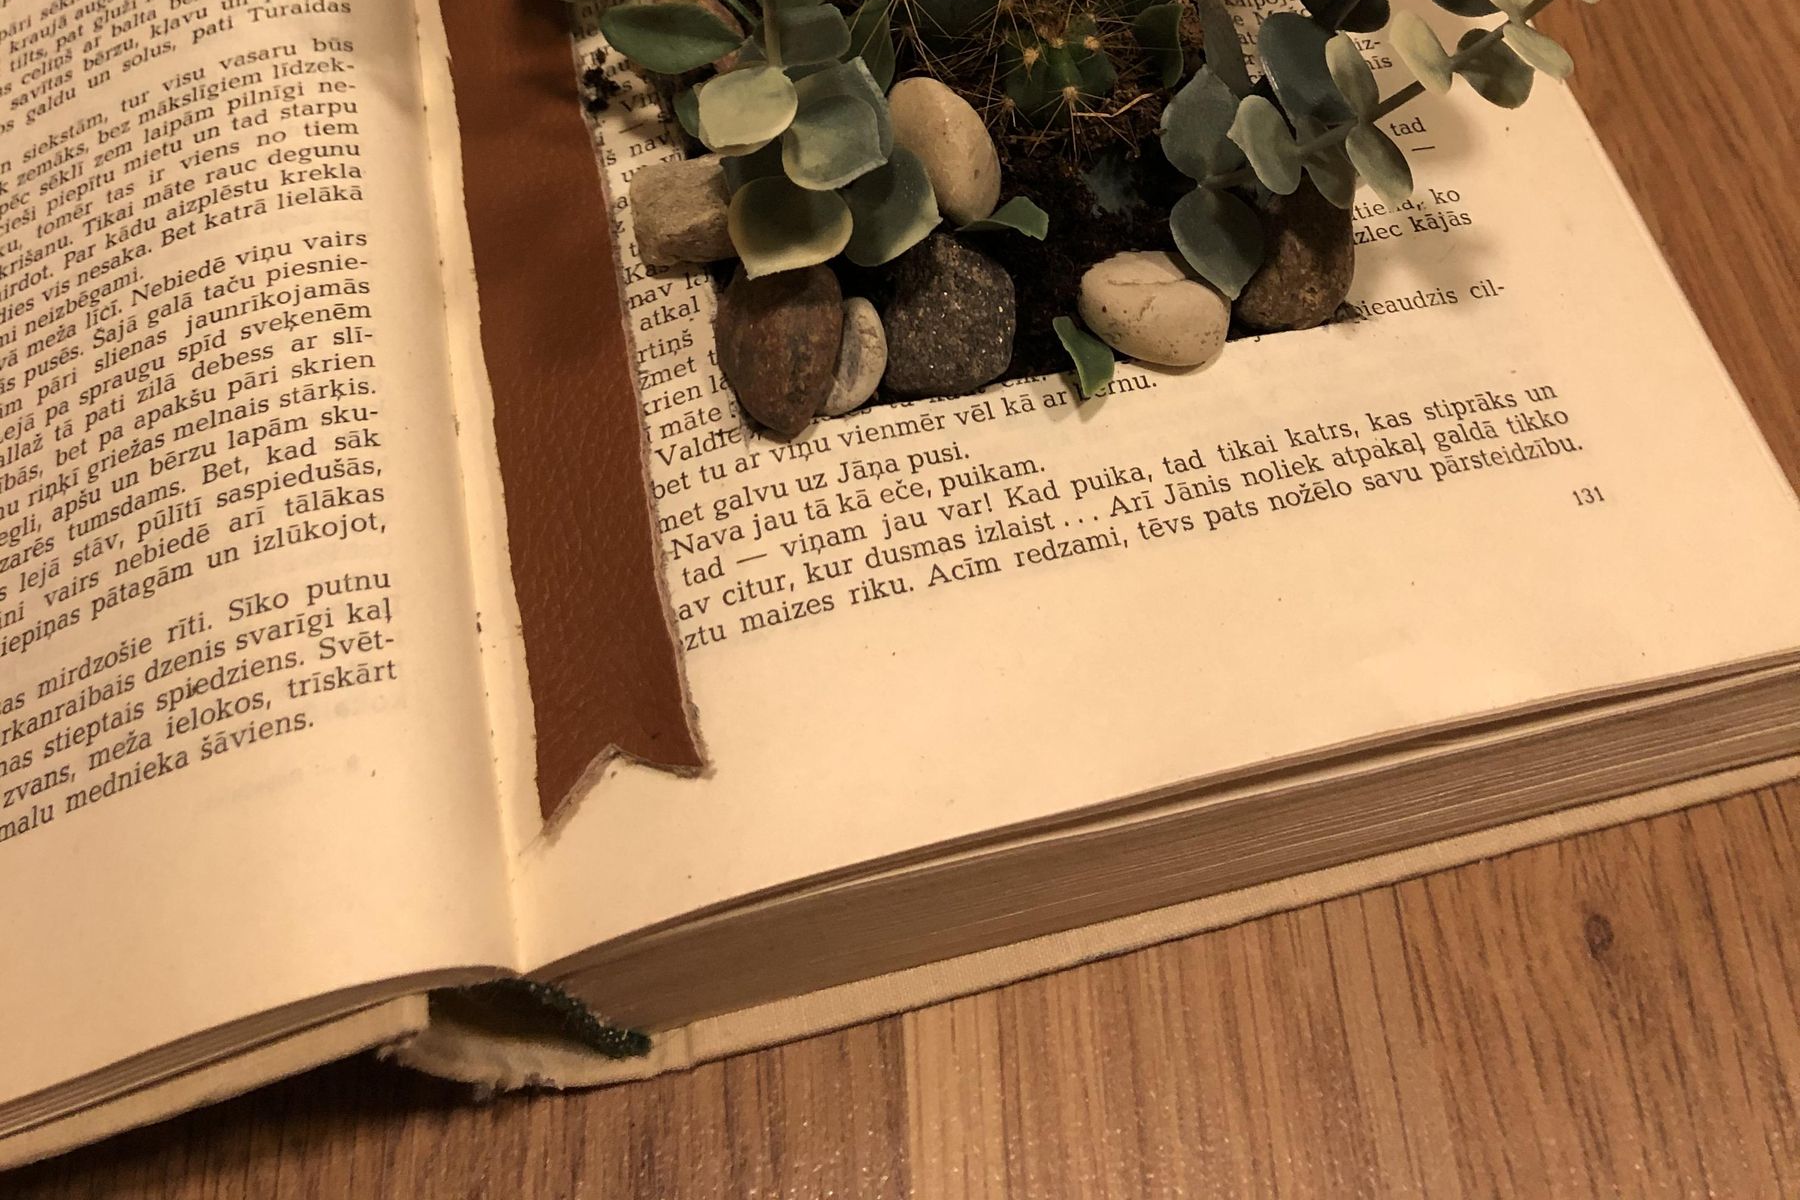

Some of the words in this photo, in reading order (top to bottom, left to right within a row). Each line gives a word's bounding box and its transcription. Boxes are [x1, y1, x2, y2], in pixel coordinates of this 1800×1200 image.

[122, 41, 176, 73] solus,
[192, 15, 234, 45] pati
[162, 67, 206, 92] visu
[218, 44, 297, 70] vasaru
[311, 37, 354, 53] būs
[138, 72, 262, 126] mākslīgiem
[272, 57, 355, 80] līdzek-
[144, 106, 215, 144] laipām
[227, 81, 304, 116] pilnīgi
[1390, 116, 1427, 137] tad
[106, 182, 134, 204] tas
[179, 141, 240, 170] viens
[304, 120, 359, 137] tiem
[124, 139, 183, 175] mietu
[231, 108, 269, 131] tad
[280, 102, 358, 120] starpu
[63, 243, 96, 271] Par
[166, 178, 269, 221] aizplēstu
[280, 163, 362, 186] krekla
[82, 204, 134, 237] Tikai
[143, 179, 195, 210] māte
[205, 159, 257, 185] rauc
[267, 144, 361, 166] degunu
[1408, 210, 1472, 233] kājās
[1428, 188, 1462, 205] ko
[76, 244, 152, 287] nesaka.
[160, 220, 196, 248] Bet
[204, 198, 268, 231] katrā
[277, 184, 364, 210] lielākā
[26, 324, 77, 359] meža
[130, 256, 226, 307] Nebiedē
[234, 242, 292, 266] viņu
[301, 230, 368, 250] vairs
[94, 329, 167, 374] slienas
[184, 278, 370, 339] jaunrīkojamās
[147, 291, 194, 329] galā
[203, 275, 256, 301] taču
[265, 254, 368, 288] piesnie-
[640, 295, 702, 332] atkal
[1469, 278, 1505, 300] cil-
[79, 356, 166, 406] spraugu
[178, 328, 227, 363] spīd
[240, 303, 372, 341] sveķenēm
[191, 345, 274, 381] debess
[333, 326, 373, 346] slī-
[227, 365, 279, 401] pāri
[291, 353, 376, 379] skrien
[149, 441, 217, 477] bērzu
[227, 416, 309, 450] lapām
[321, 405, 379, 426] sku-
[172, 397, 270, 442] melnais
[279, 377, 376, 408] stārķis.
[659, 407, 722, 440] māte
[698, 463, 728, 484] tu
[735, 452, 760, 474] ar
[768, 437, 832, 463] viņu
[837, 415, 946, 447] vienmēr
[953, 401, 996, 426] vēl
[1000, 397, 1036, 417] kā
[1042, 389, 1068, 409] ar
[1072, 374, 1158, 402] rnu.
[68, 480, 186, 542] tumsdams.
[202, 456, 250, 485] Bet,
[266, 436, 317, 466] kad
[334, 428, 382, 451] sāk
[137, 496, 202, 544] pūlītī
[216, 457, 382, 508] saspiedušās,
[229, 505, 265, 533] arī
[284, 486, 385, 517] tālākas
[670, 524, 746, 561] Nava
[752, 510, 798, 541] jau
[803, 498, 832, 521] tā
[835, 488, 872, 514] kā
[880, 479, 932, 504] eče,
[938, 459, 1045, 498] puikam.
[682, 555, 726, 587] tad
[779, 524, 868, 557] viņam
[882, 511, 928, 540] jau
[937, 492, 993, 521] var!
[1003, 479, 1061, 509] Kad
[1070, 466, 1153, 501] puika,
[1162, 448, 1207, 475] tad
[1216, 434, 1279, 462] tikai
[1284, 423, 1359, 448] katrs,
[1364, 411, 1412, 432] kas
[1423, 391, 1518, 421] stiprāks
[1524, 385, 1558, 403] un
[713, 482, 790, 521] galvu
[795, 472, 828, 493] uz
[837, 458, 901, 484] Jāņa
[906, 441, 970, 475] pusi.
[722, 574, 794, 607] citur,
[802, 557, 853, 585] kur
[865, 533, 966, 569] dusmas
[974, 511, 1056, 545] izlaist
[1109, 490, 1155, 518] Arī
[1164, 474, 1232, 505] Jānis
[1240, 454, 1325, 487] noliek
[1331, 432, 1426, 468] atpakaļ
[1433, 420, 1500, 452] galdā
[1506, 409, 1569, 435] tikko
[1572, 486, 1605, 506] 131
[91, 562, 194, 622] pātagām
[206, 546, 240, 569] un
[253, 512, 386, 556] izlūkojot,
[739, 594, 835, 634] maizes
[848, 577, 914, 606] riku.
[927, 557, 1002, 588] Acīm
[1013, 526, 1128, 568] redzami,
[1137, 515, 1194, 541] tēvs
[1202, 500, 1259, 532] pats
[1267, 478, 1352, 512] nožēlo
[1362, 466, 1423, 492] savu
[1429, 437, 1583, 483] pārsteidzību.
[37, 637, 152, 699] mirdzošie
[167, 611, 212, 644] rīti.
[228, 592, 289, 622] Sīko
[306, 573, 391, 607] putnu
[144, 639, 226, 683] dzenis
[236, 607, 334, 651] svarīgi
[346, 597, 392, 625] kaļ
[156, 651, 304, 713] spiedziens.
[319, 630, 394, 660] Svēt-
[2, 764, 76, 809] zvans,
[88, 729, 152, 771] meža
[166, 691, 271, 740] ielokos,
[287, 660, 398, 699] trīskārt
[65, 750, 190, 814] mednieka
[200, 712, 314, 761] šāviens.
